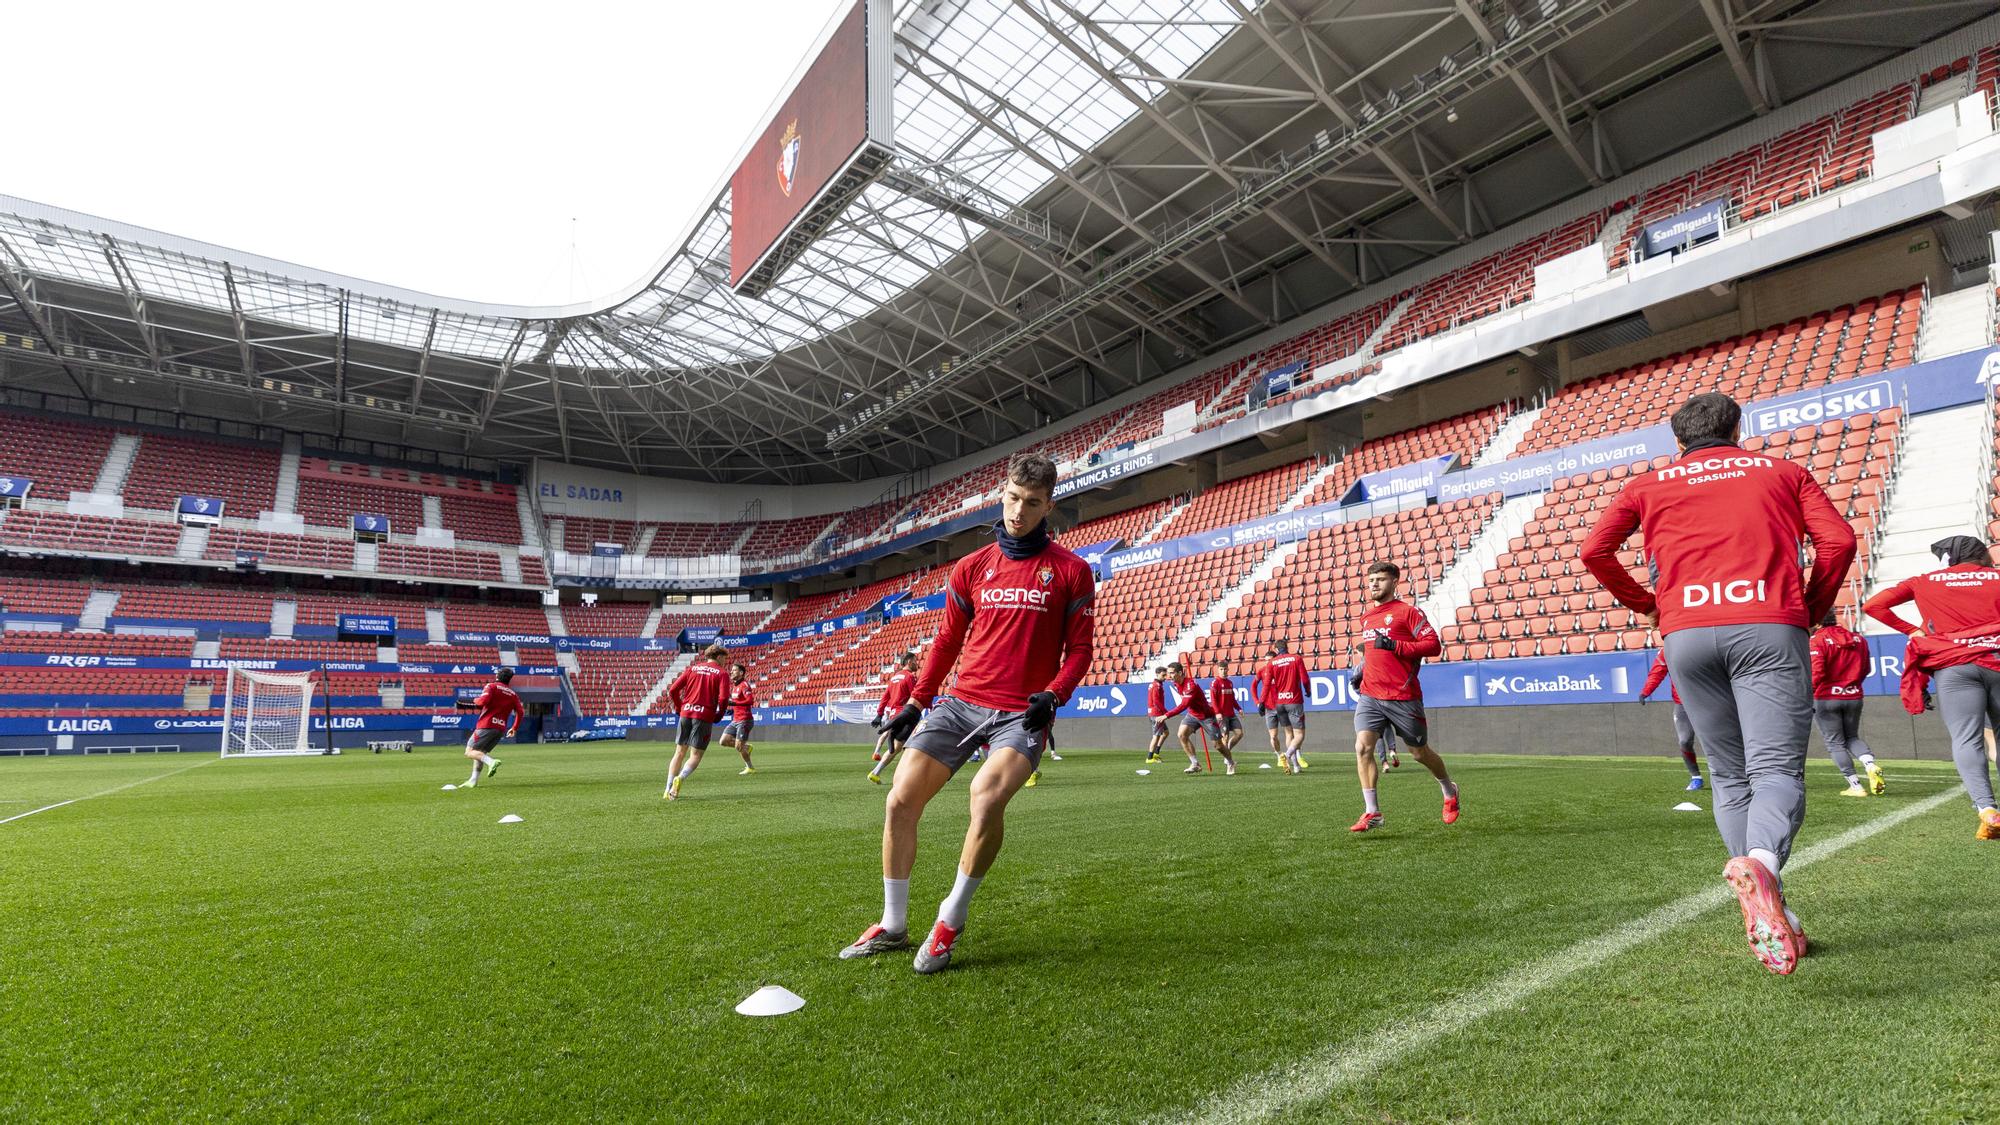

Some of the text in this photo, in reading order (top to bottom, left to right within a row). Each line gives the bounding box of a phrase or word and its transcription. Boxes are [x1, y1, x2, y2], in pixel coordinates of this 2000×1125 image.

[1652, 212, 1712, 243] SanMiguel
[1759, 388, 1881, 431] EROSKI
[1077, 470, 1108, 489] NUNCA
[1110, 464, 1121, 477] SE
[1123, 453, 1153, 472] RINDE
[1441, 442, 1646, 497] Parques Solares de Navarra
[1658, 457, 1773, 481] macron
[1688, 470, 1746, 485] OSASUNA
[541, 484, 622, 502] EL SADAR
[1367, 471, 1433, 500] SanMiguel
[1233, 515, 1305, 541] SERCOIN
[1111, 547, 1163, 568] INAMAN
[1929, 572, 2000, 582] macron
[1683, 579, 1766, 608] DIGI
[495, 634, 550, 644] CONECTAPISOS
[590, 640, 612, 649] Gazpi
[46, 655, 101, 667] ARGA
[692, 665, 720, 674] macron
[1510, 674, 1602, 693] CaixaBank
[683, 703, 704, 713] DIGI
[48, 719, 113, 732] LALIGA
[315, 718, 365, 729] LALIGA
[432, 715, 462, 725] Mocay
